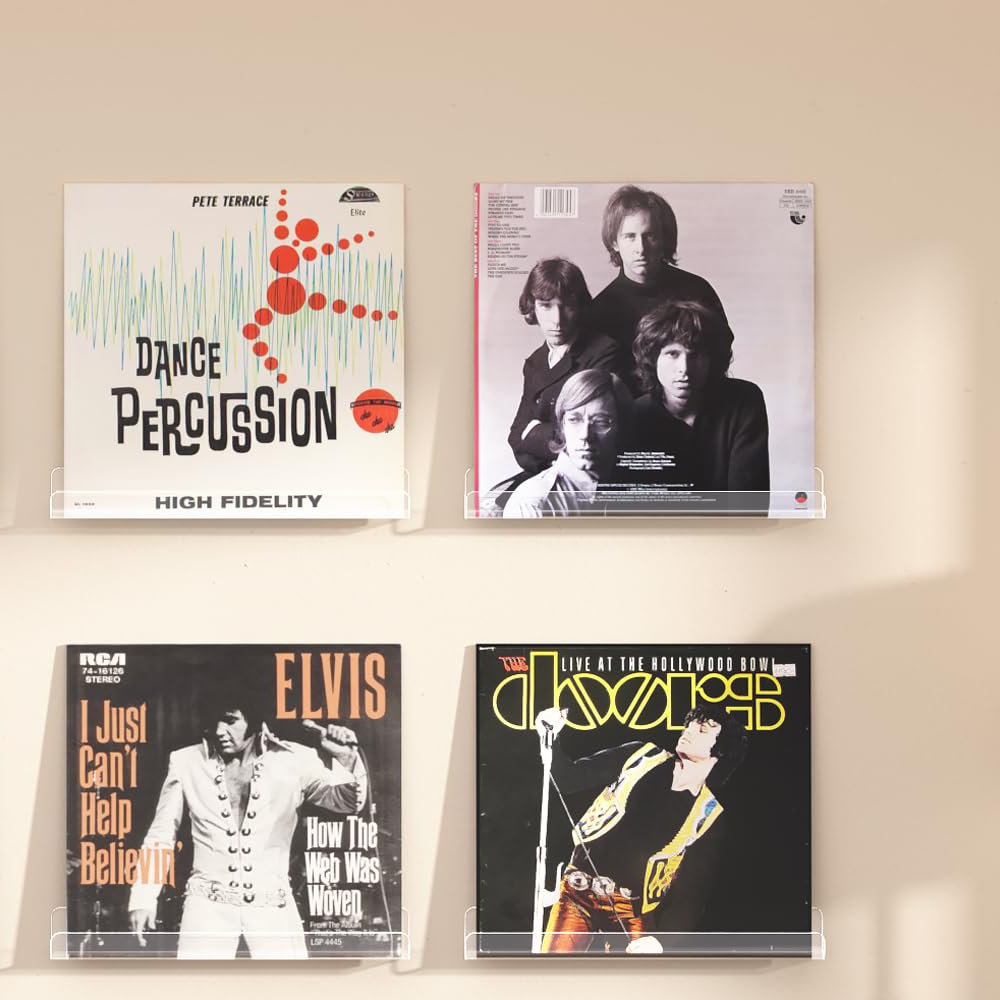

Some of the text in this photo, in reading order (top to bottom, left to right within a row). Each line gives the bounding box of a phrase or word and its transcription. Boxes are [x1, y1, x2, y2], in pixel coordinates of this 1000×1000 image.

[192, 195, 270, 207] PETE TERRACE
[350, 208, 367, 217] Elite
[136, 336, 221, 386] DANCE
[110, 385, 338, 456] PERCUSSION
[155, 494, 323, 509] HIGH FIDELITY
[80, 652, 126, 666] RCA
[561, 656, 591, 672] LIVE
[598, 656, 613, 672] AT
[620, 656, 644, 672] THE
[651, 656, 733, 672] HOLLYWOOD
[85, 675, 121, 683] STEREO
[275, 652, 387, 719] ELVIS
[81, 699, 147, 744] I Just
[79, 744, 138, 792] Can't
[81, 791, 132, 840] Help
[306, 815, 378, 851] How The
[80, 841, 183, 888] Believin'
[304, 851, 380, 884] Web Was
[307, 884, 362, 917] Woven
